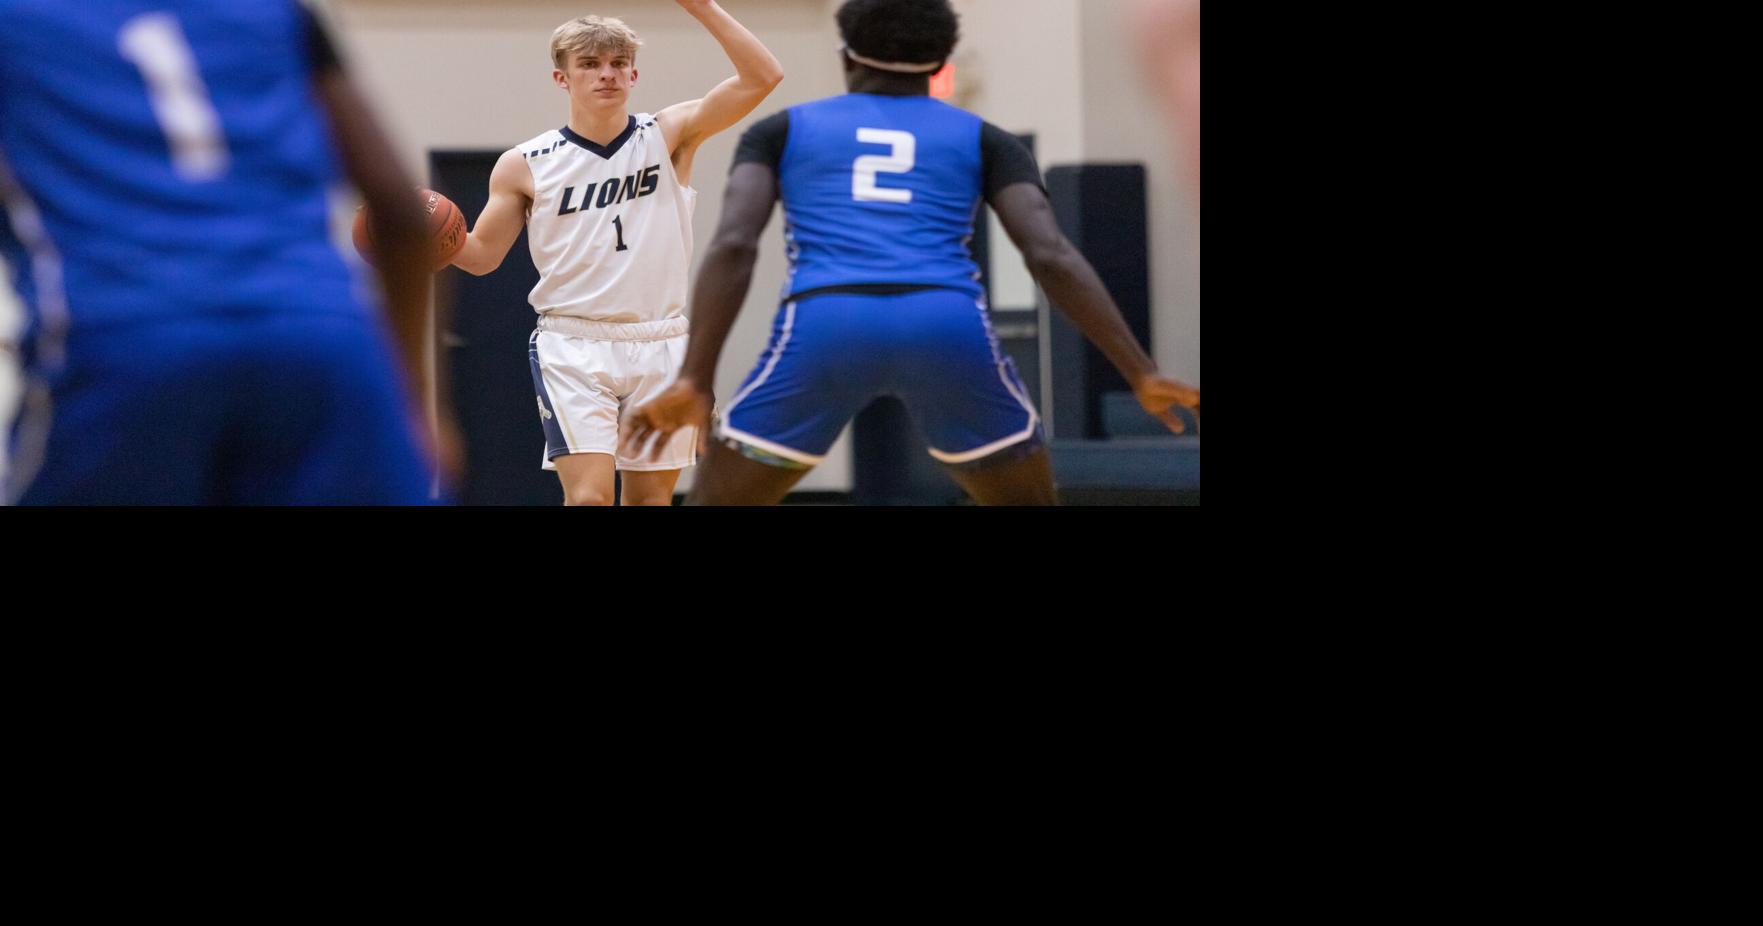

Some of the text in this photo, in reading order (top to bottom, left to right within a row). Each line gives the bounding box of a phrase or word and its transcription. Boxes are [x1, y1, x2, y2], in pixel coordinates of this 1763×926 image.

[119, 12, 229, 180] 1
[557, 164, 660, 216] LIONS
[852, 127, 916, 204] 2
[612, 214, 628, 252] 1
